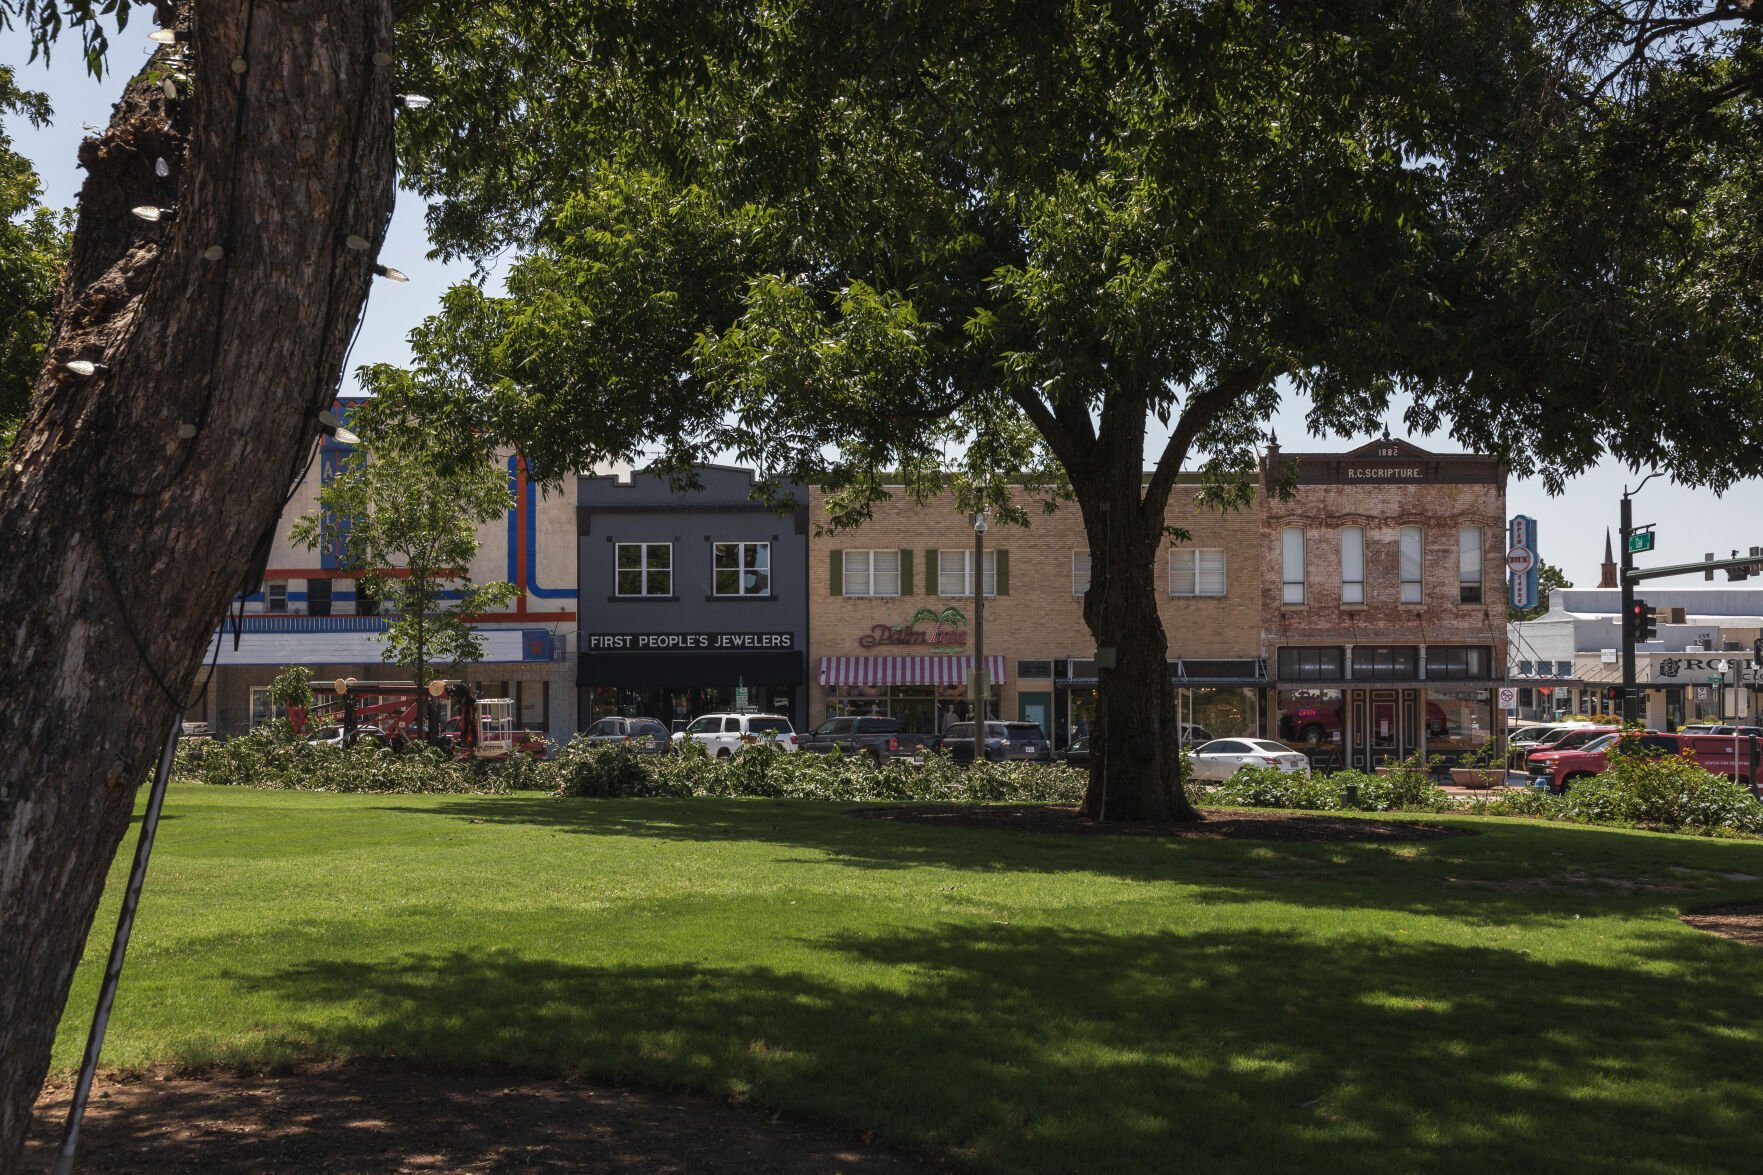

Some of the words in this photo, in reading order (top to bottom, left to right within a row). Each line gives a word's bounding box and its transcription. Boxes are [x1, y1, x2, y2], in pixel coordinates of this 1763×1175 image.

[590, 636, 632, 648] FIRST
[639, 635, 708, 648] PEOPLE'S
[713, 635, 791, 647] JEWELERS
